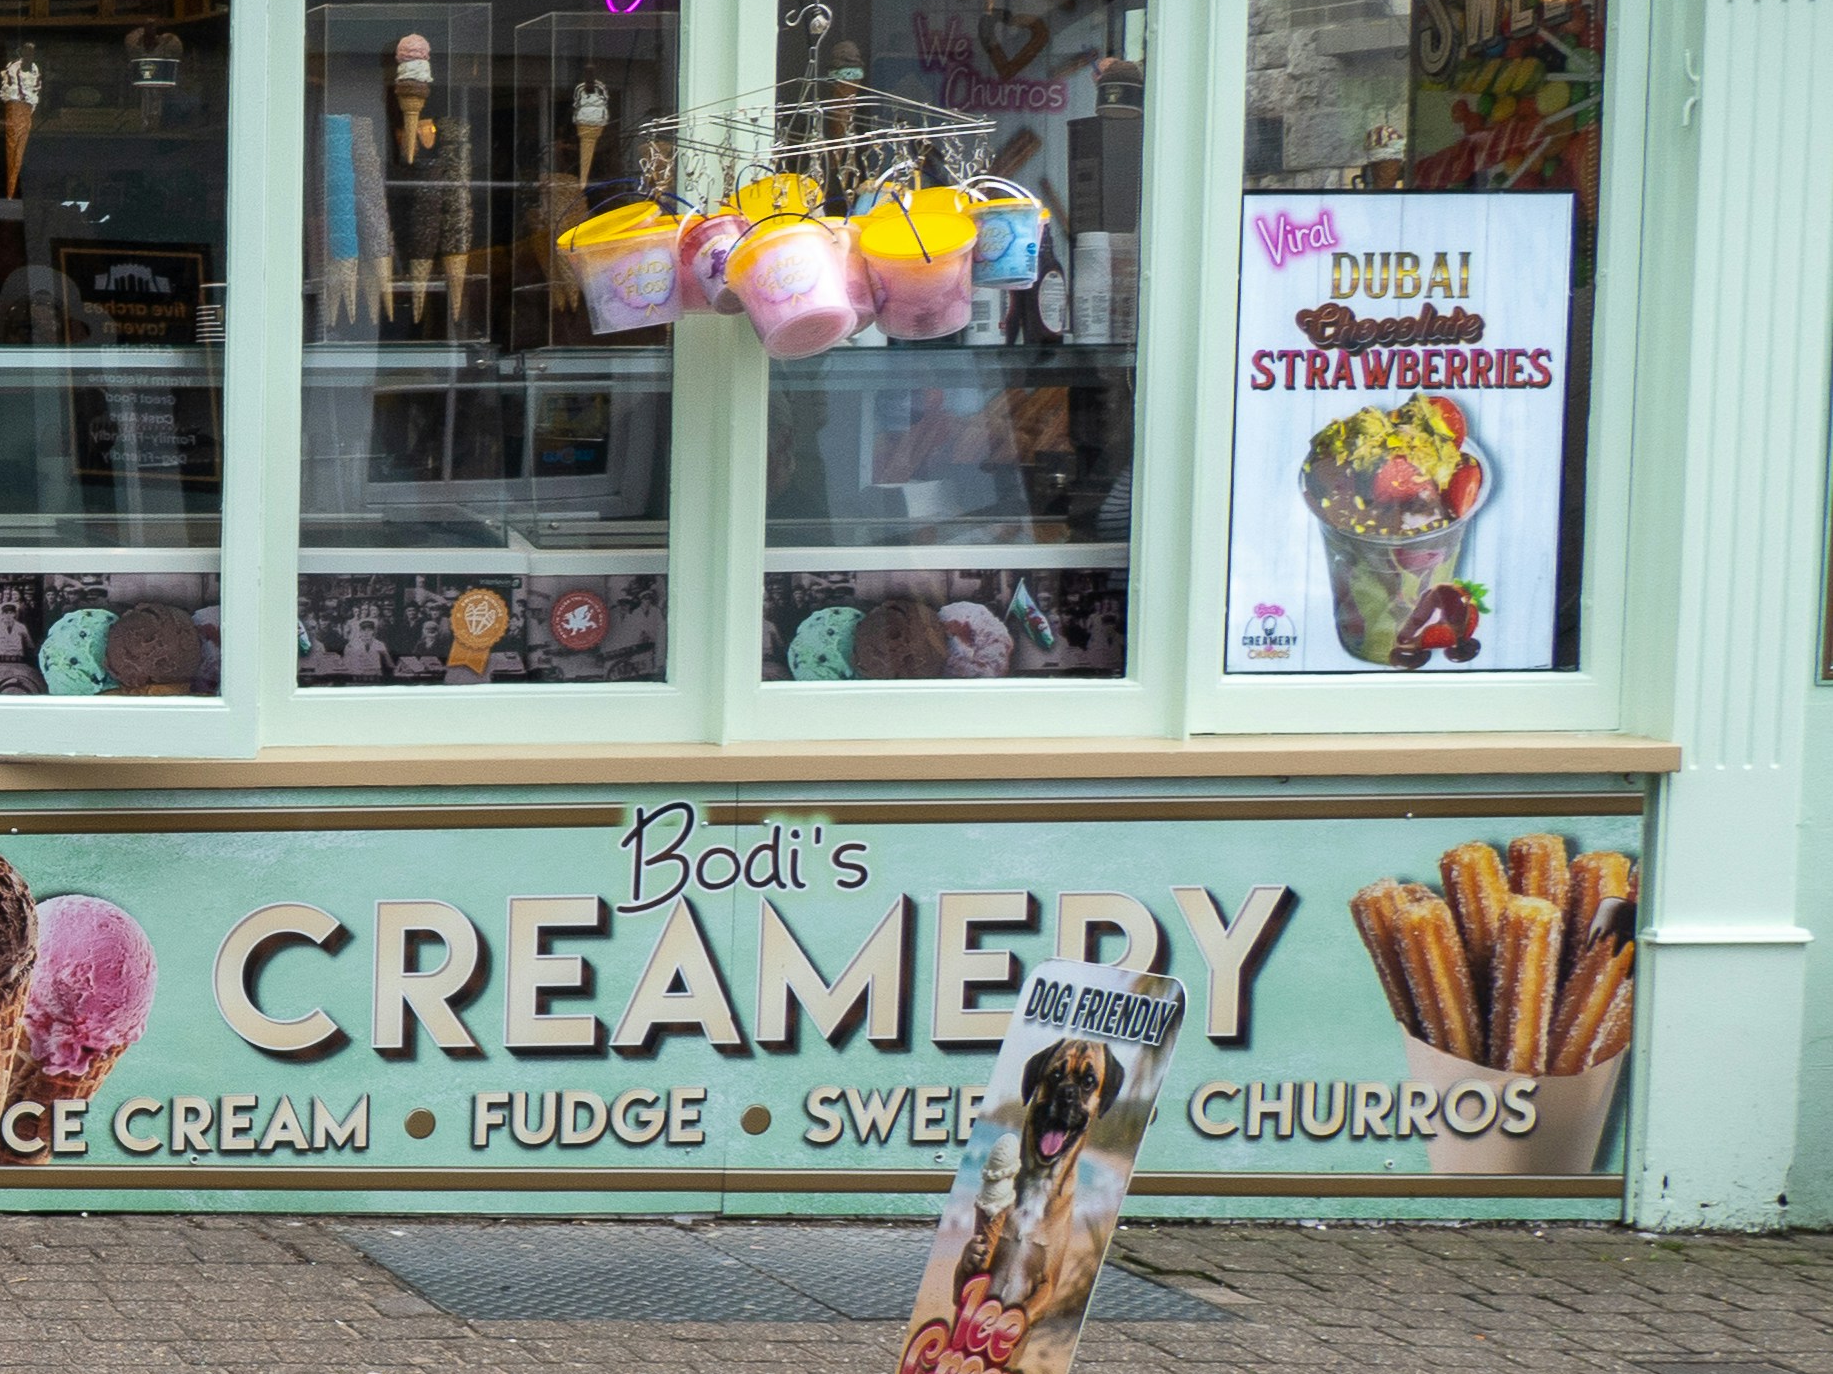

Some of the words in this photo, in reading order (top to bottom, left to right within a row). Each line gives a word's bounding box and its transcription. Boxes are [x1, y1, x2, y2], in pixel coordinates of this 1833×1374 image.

[915, 14, 969, 68] We
[945, 67, 1063, 112] Churros
[1256, 213, 1335, 266] Viral
[624, 278, 668, 301] FLOSS
[1331, 251, 1472, 300] DUBAI
[1296, 302, 1486, 350] Chocolate
[1251, 348, 1553, 390] STRAWBERRIES
[1242, 636, 1298, 646] CREAMERY
[617, 802, 869, 913] Bodi's
[1025, 977, 1074, 1026] DOG
[1074, 987, 1179, 1048] FRIENDLY
[114, 1093, 370, 1155] CREAM
[472, 1088, 708, 1149] FUDGE
[1189, 1079, 1538, 1141] CHURROS
[954, 1273, 1029, 1369] Ice
